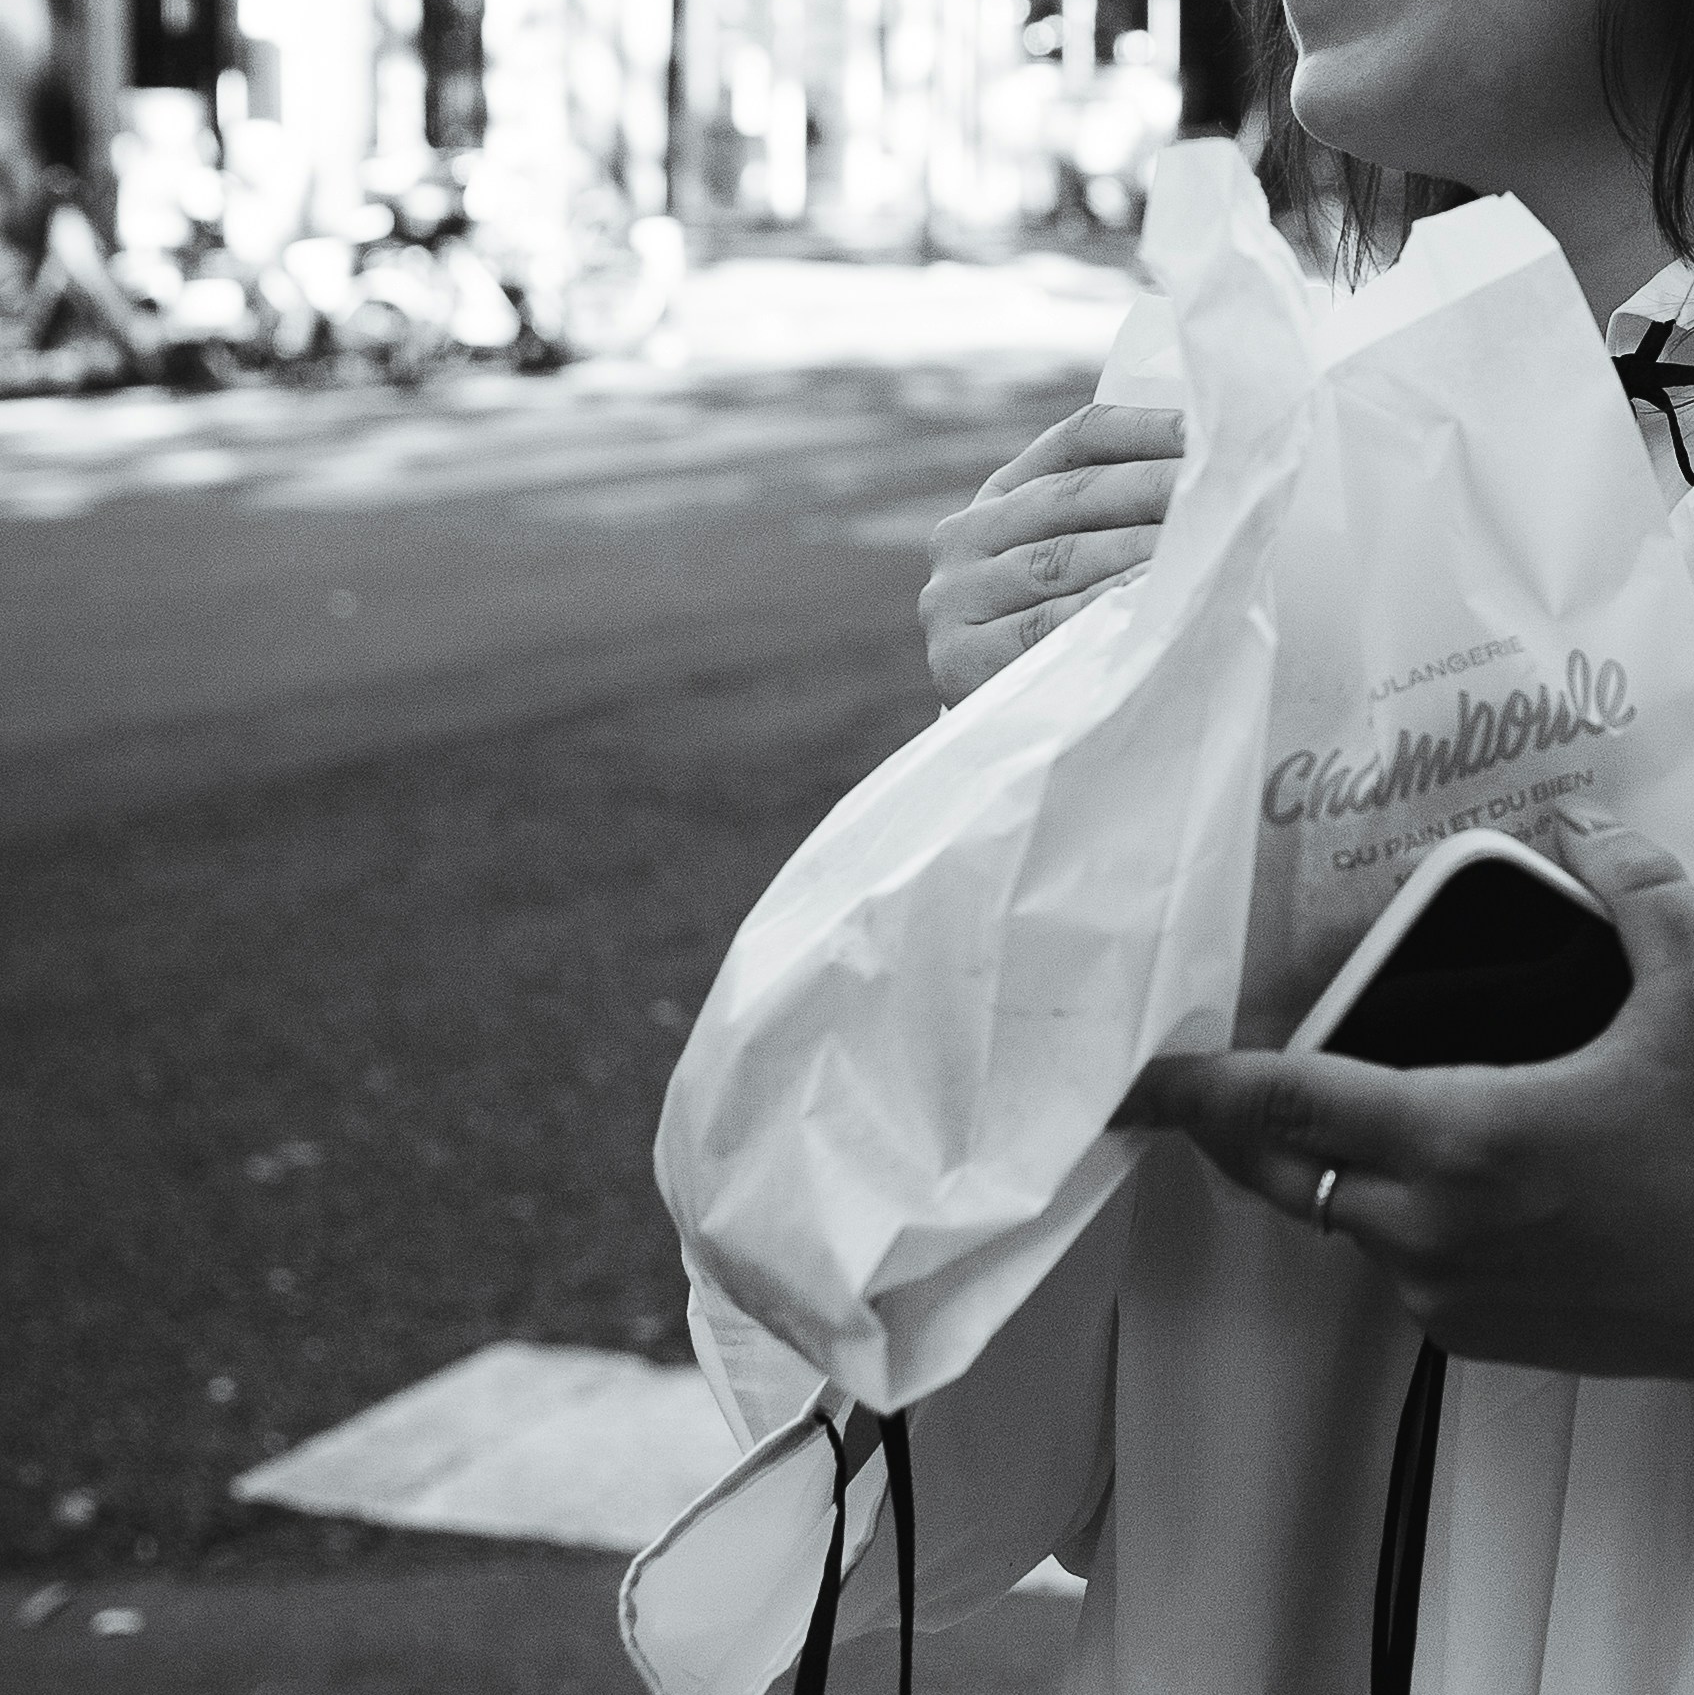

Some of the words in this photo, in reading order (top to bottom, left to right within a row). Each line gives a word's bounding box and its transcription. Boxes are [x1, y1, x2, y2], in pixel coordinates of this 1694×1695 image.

[1367, 636, 1526, 702] ULANGERIE
[1262, 649, 1636, 825] Chamboule
[1382, 820, 1448, 858] PAIN
[1449, 806, 1484, 834] ET
[1486, 789, 1528, 820] DU
[1529, 769, 1595, 805] BIEN
